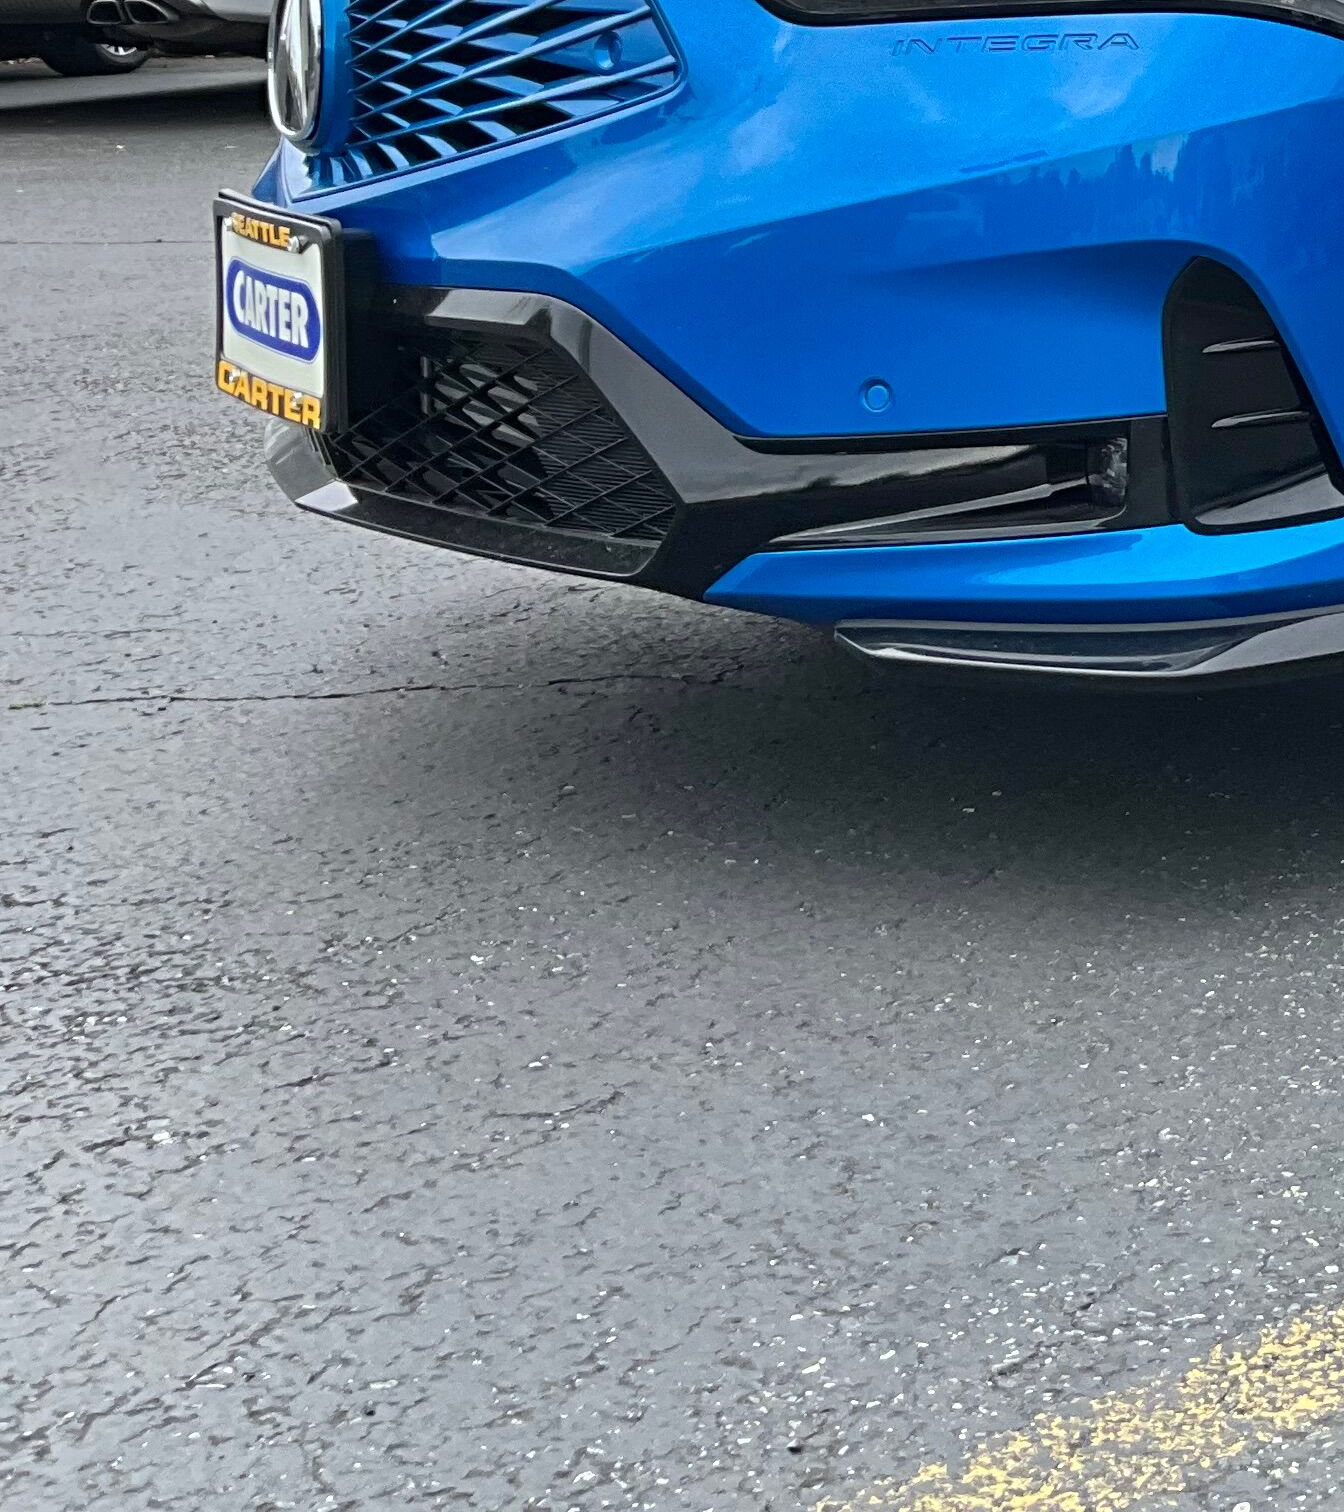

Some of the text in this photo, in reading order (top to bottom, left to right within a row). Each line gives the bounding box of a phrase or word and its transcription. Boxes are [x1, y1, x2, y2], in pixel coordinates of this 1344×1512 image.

[891, 32, 1140, 57] INTEGRA
[231, 211, 290, 248] SEATTLE
[232, 269, 309, 348] CARTER
[217, 359, 321, 430] CARTER
